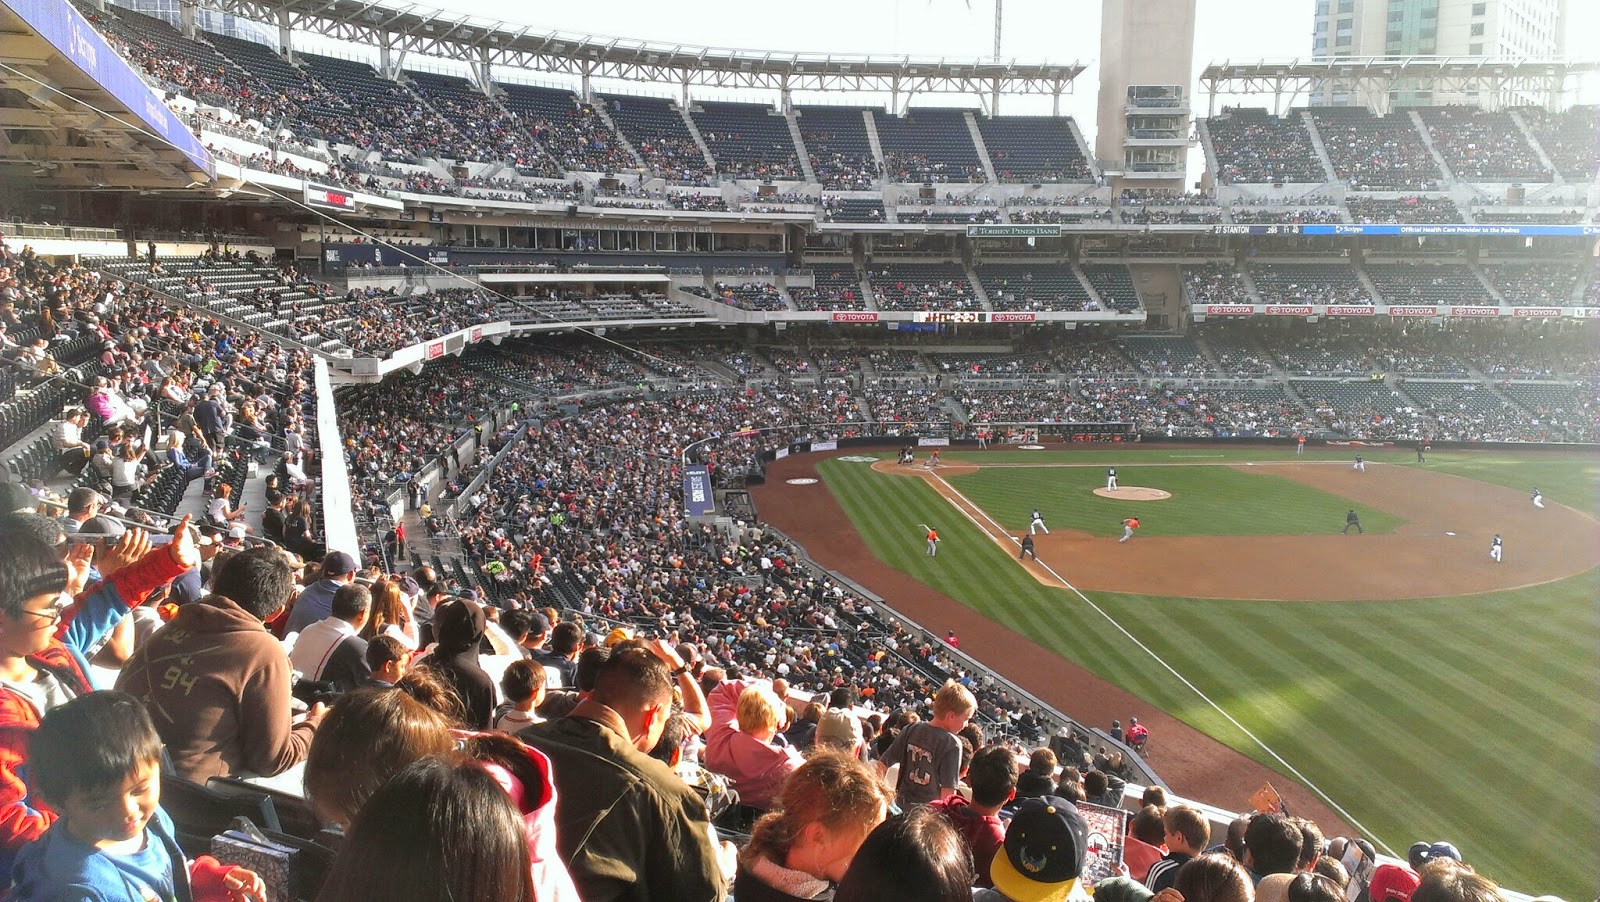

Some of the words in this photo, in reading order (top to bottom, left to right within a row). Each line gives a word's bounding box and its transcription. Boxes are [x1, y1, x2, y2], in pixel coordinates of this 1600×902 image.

[515, 220, 546, 228] JERRY
[551, 221, 599, 230] COLEMAN
[603, 223, 666, 231] BROADCAST
[671, 225, 712, 233] CENTER
[1222, 226, 1250, 234] STANTON
[1344, 226, 1364, 234] Scripps
[979, 227, 1009, 235] TORREY
[1012, 227, 1036, 235] PINES
[1037, 227, 1059, 235] BANK
[1005, 313, 1032, 321] TOYOTA
[160, 665, 200, 697] 94
